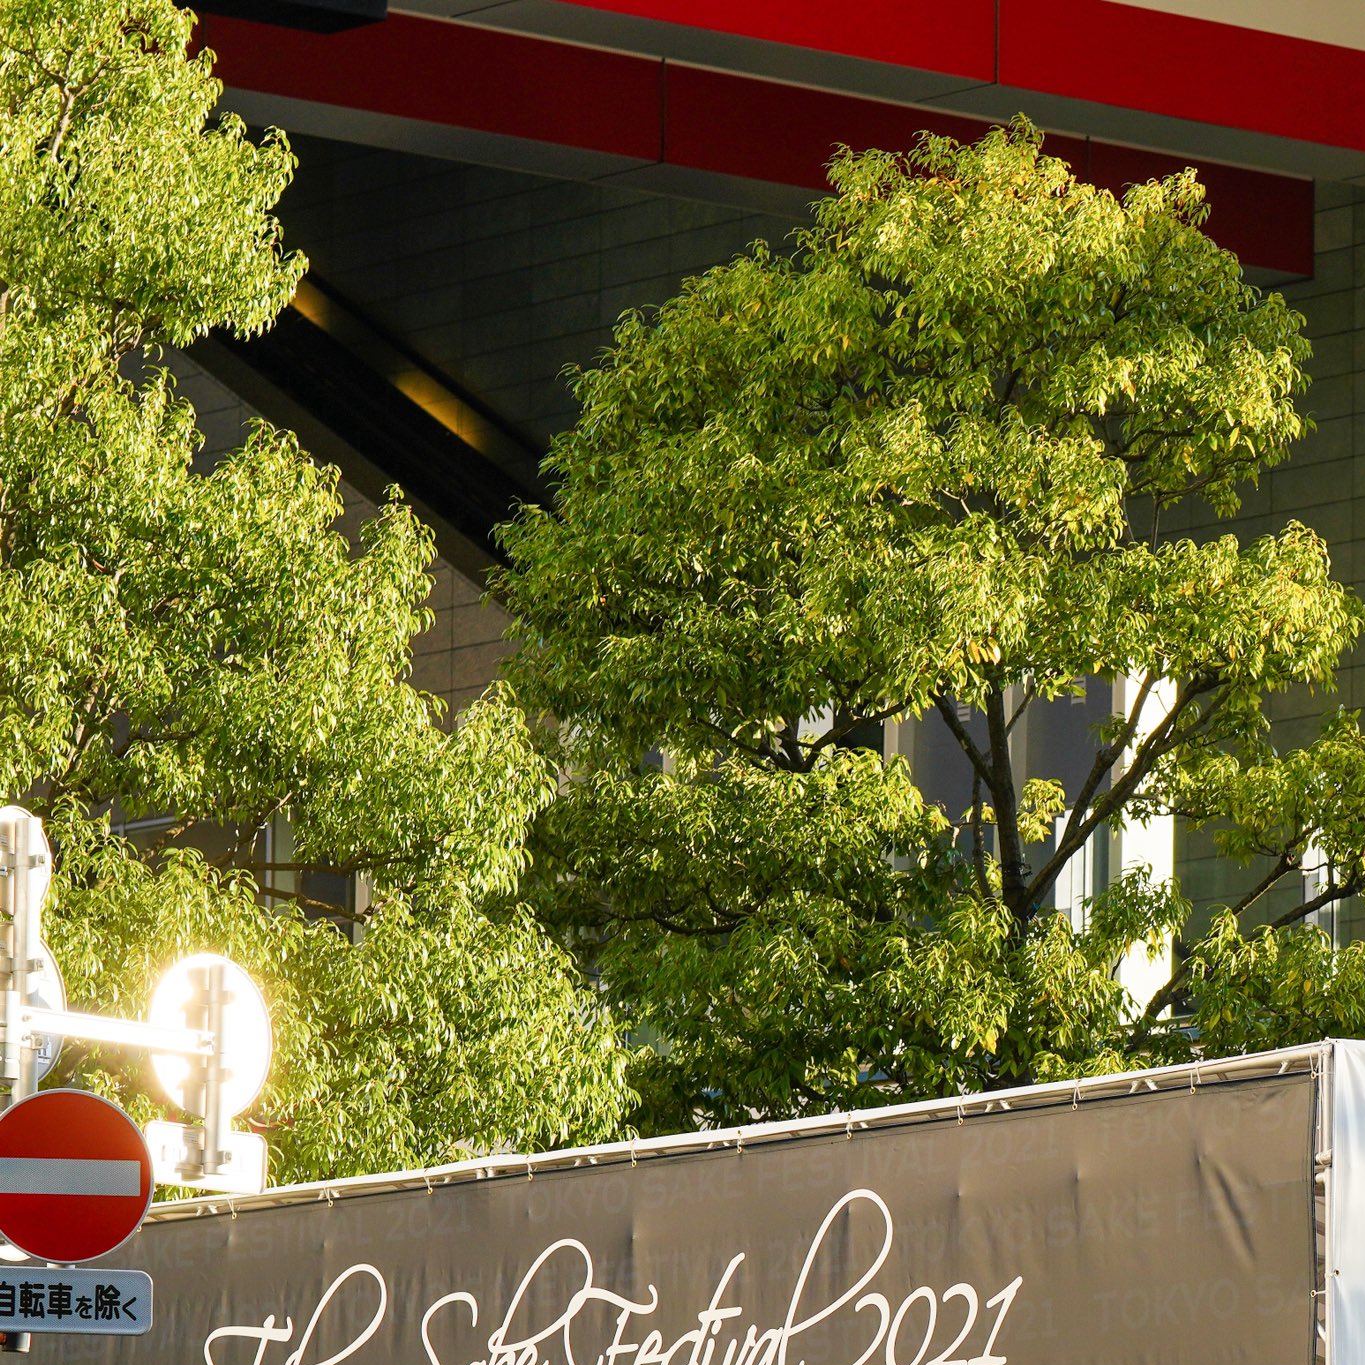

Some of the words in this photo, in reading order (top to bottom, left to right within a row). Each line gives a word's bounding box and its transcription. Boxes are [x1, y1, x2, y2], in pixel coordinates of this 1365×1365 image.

[0, 1281, 138, 1322] 自転車を除く
